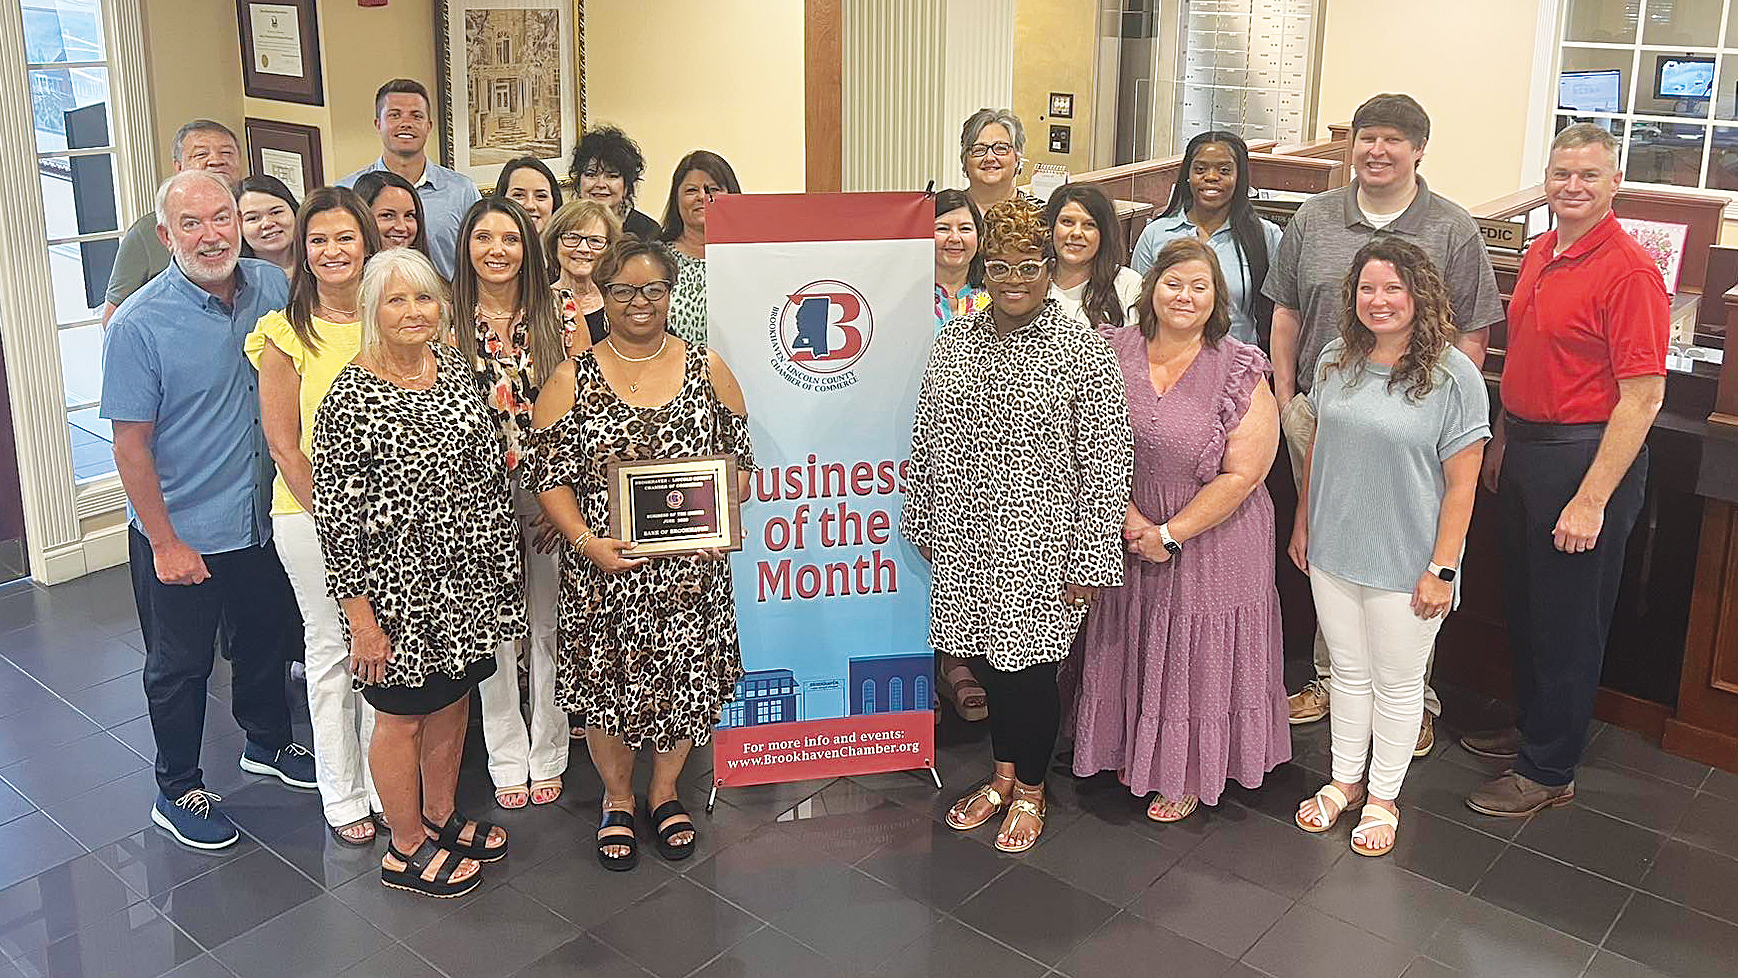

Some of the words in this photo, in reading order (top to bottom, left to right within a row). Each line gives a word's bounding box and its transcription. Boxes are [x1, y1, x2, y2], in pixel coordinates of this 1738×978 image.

[1480, 227, 1512, 240] FDIC
[769, 306, 784, 362] BROOKHAVEN
[787, 365, 820, 384] LINCOLN
[822, 369, 855, 385] COUNTY
[770, 358, 801, 387] CHAMBER
[802, 382, 812, 391] OF
[814, 376, 859, 392] COMMERCE
[764, 504, 810, 552] of
[818, 502, 890, 548] the
[756, 550, 898, 603] Month
[727, 741, 920, 769] www.BrookhavenChamber.org
[743, 742, 765, 754] For
[768, 739, 801, 750] more
[804, 734, 830, 748] info
[833, 731, 857, 745] and
[860, 729, 905, 742] events:
